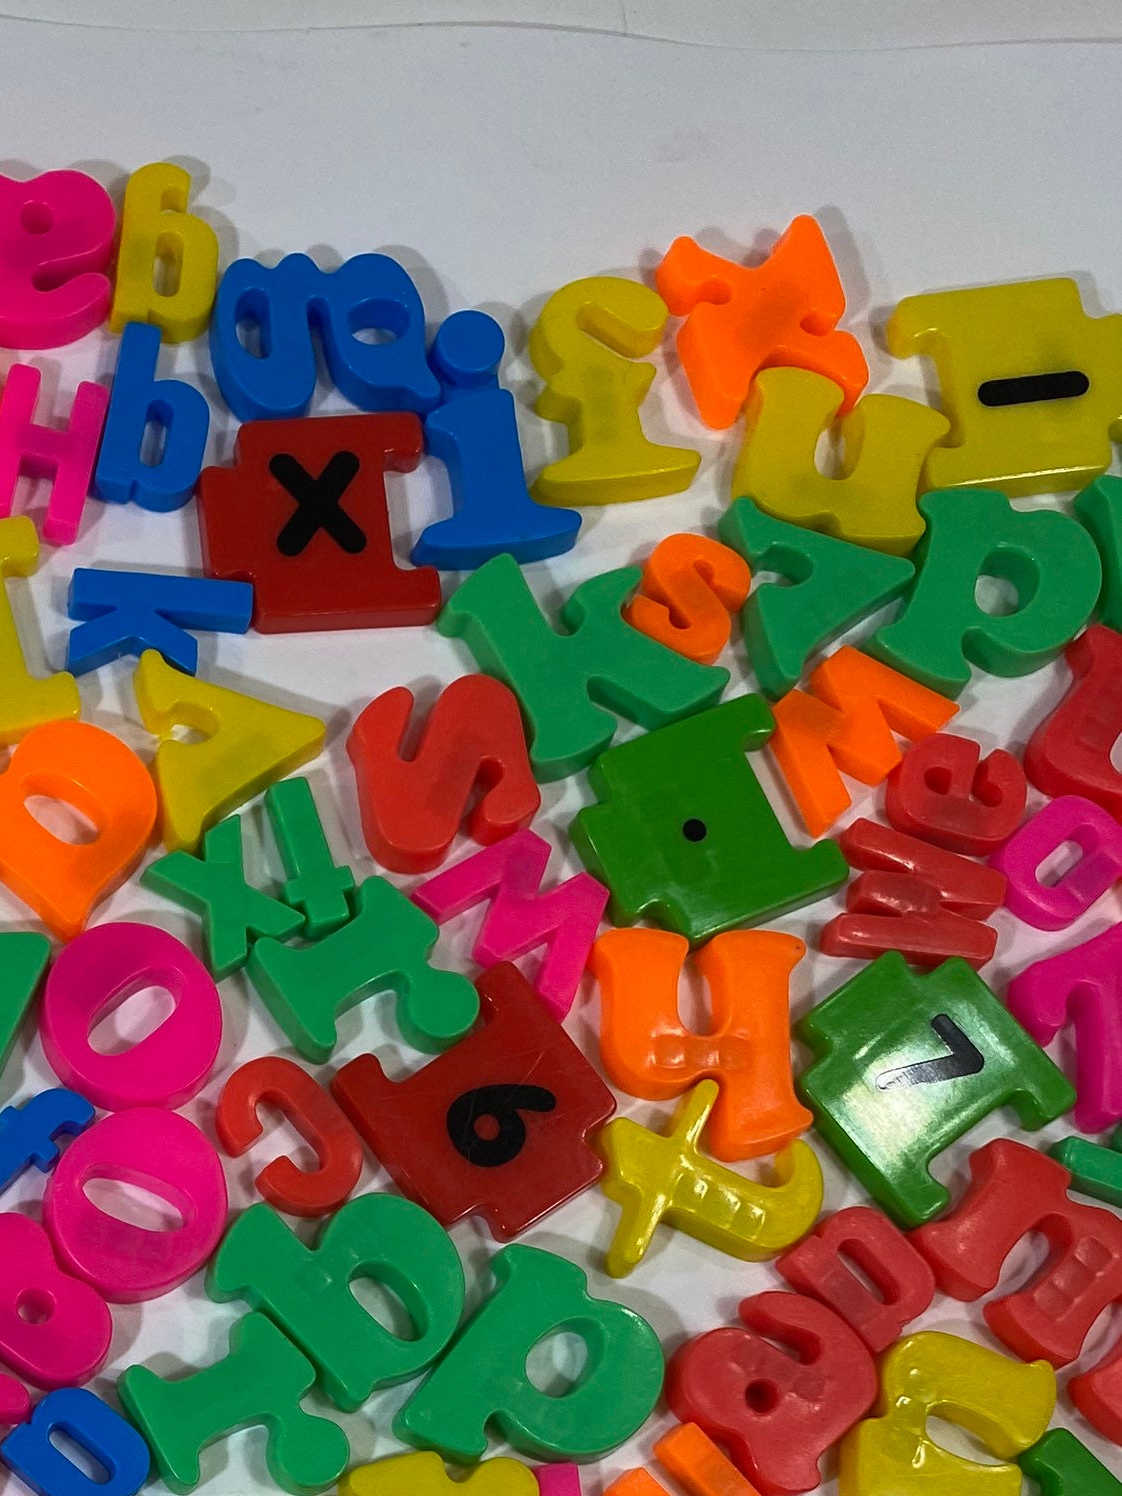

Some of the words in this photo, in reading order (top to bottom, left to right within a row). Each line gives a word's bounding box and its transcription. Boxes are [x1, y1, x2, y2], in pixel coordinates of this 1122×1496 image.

[409, 309, 584, 572] i
[528, 275, 703, 508] f
[436, 551, 733, 783] k
[629, 531, 752, 666] s
[875, 486, 1104, 690] p
[216, 1055, 366, 1218] c
[875, 1012, 985, 1091] 7
